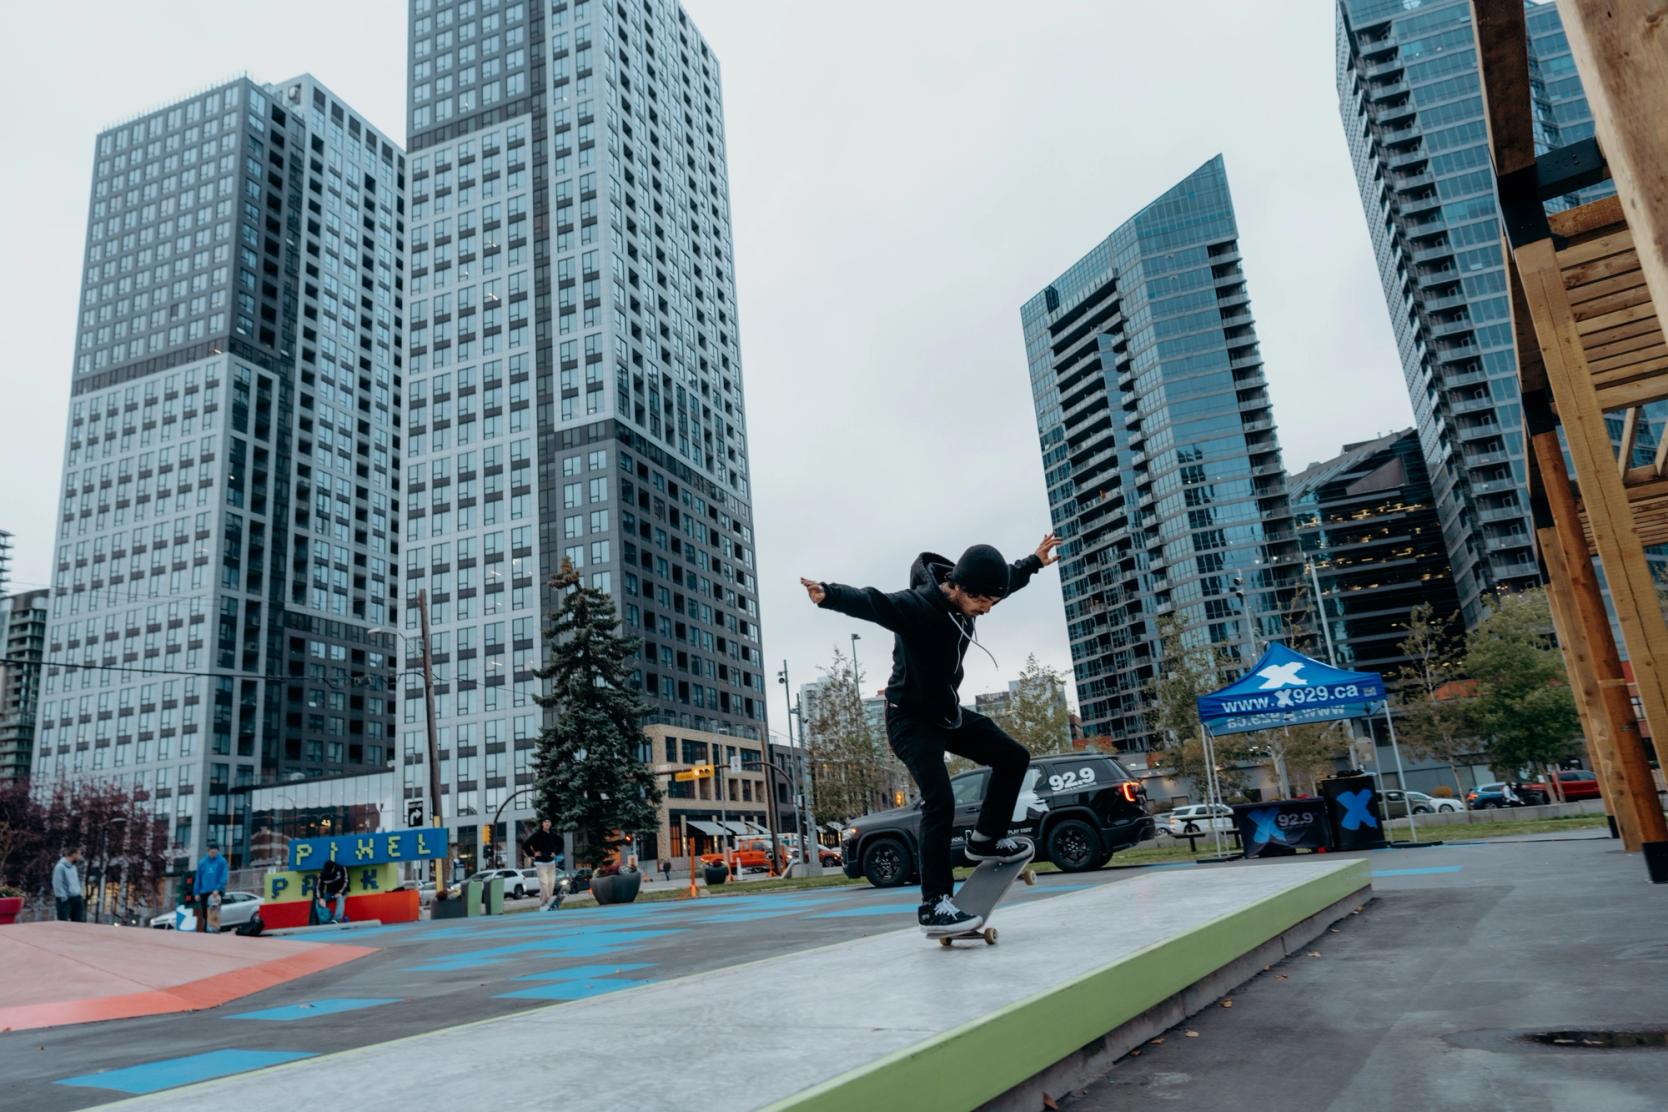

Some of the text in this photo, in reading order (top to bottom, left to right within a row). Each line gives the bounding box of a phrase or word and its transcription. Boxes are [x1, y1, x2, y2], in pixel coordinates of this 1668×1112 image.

[1048, 766, 1096, 791] 92.9
[1278, 811, 1314, 827] 92.9
[296, 832, 431, 866] PIXEL
[271, 868, 379, 899] PAK
